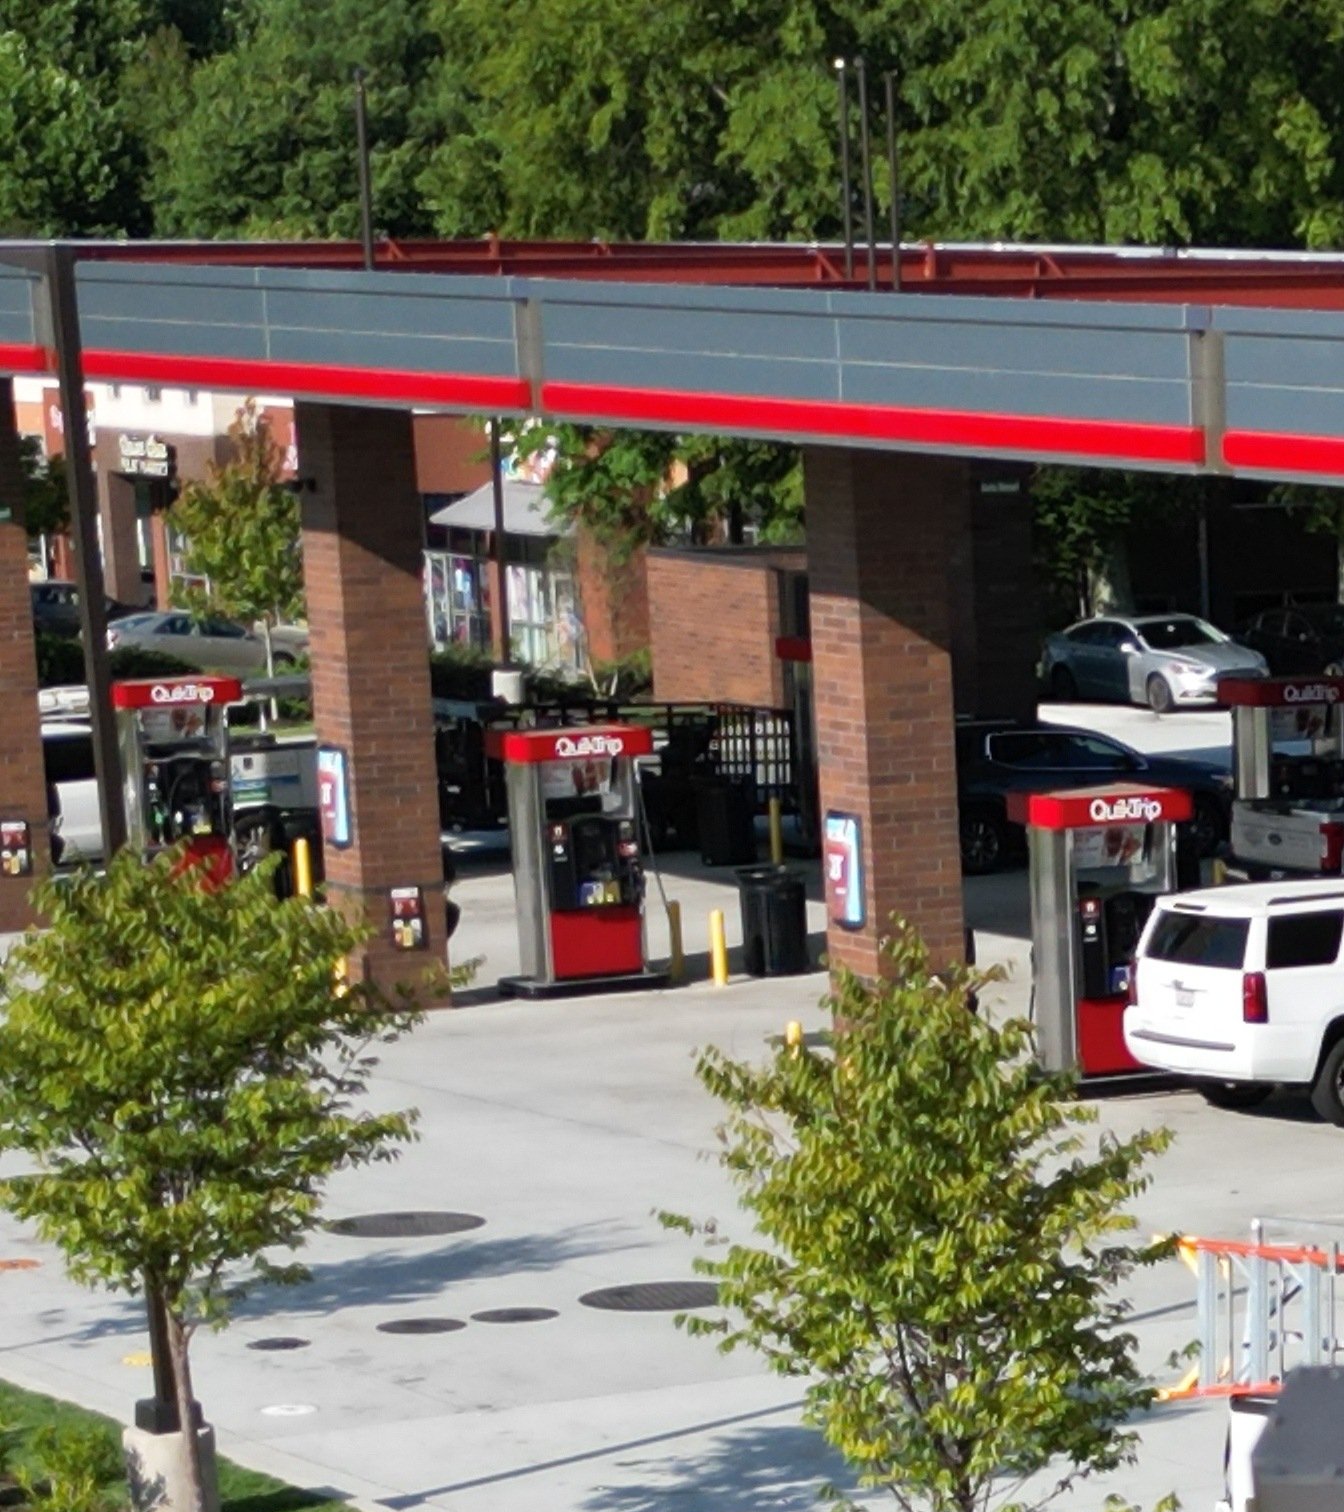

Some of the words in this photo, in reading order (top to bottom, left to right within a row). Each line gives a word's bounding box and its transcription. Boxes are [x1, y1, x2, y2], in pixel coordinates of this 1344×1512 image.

[1284, 684, 1339, 703] QuikTrip
[556, 736, 623, 756] QuikTrip
[1090, 797, 1161, 821] QuikTrip
